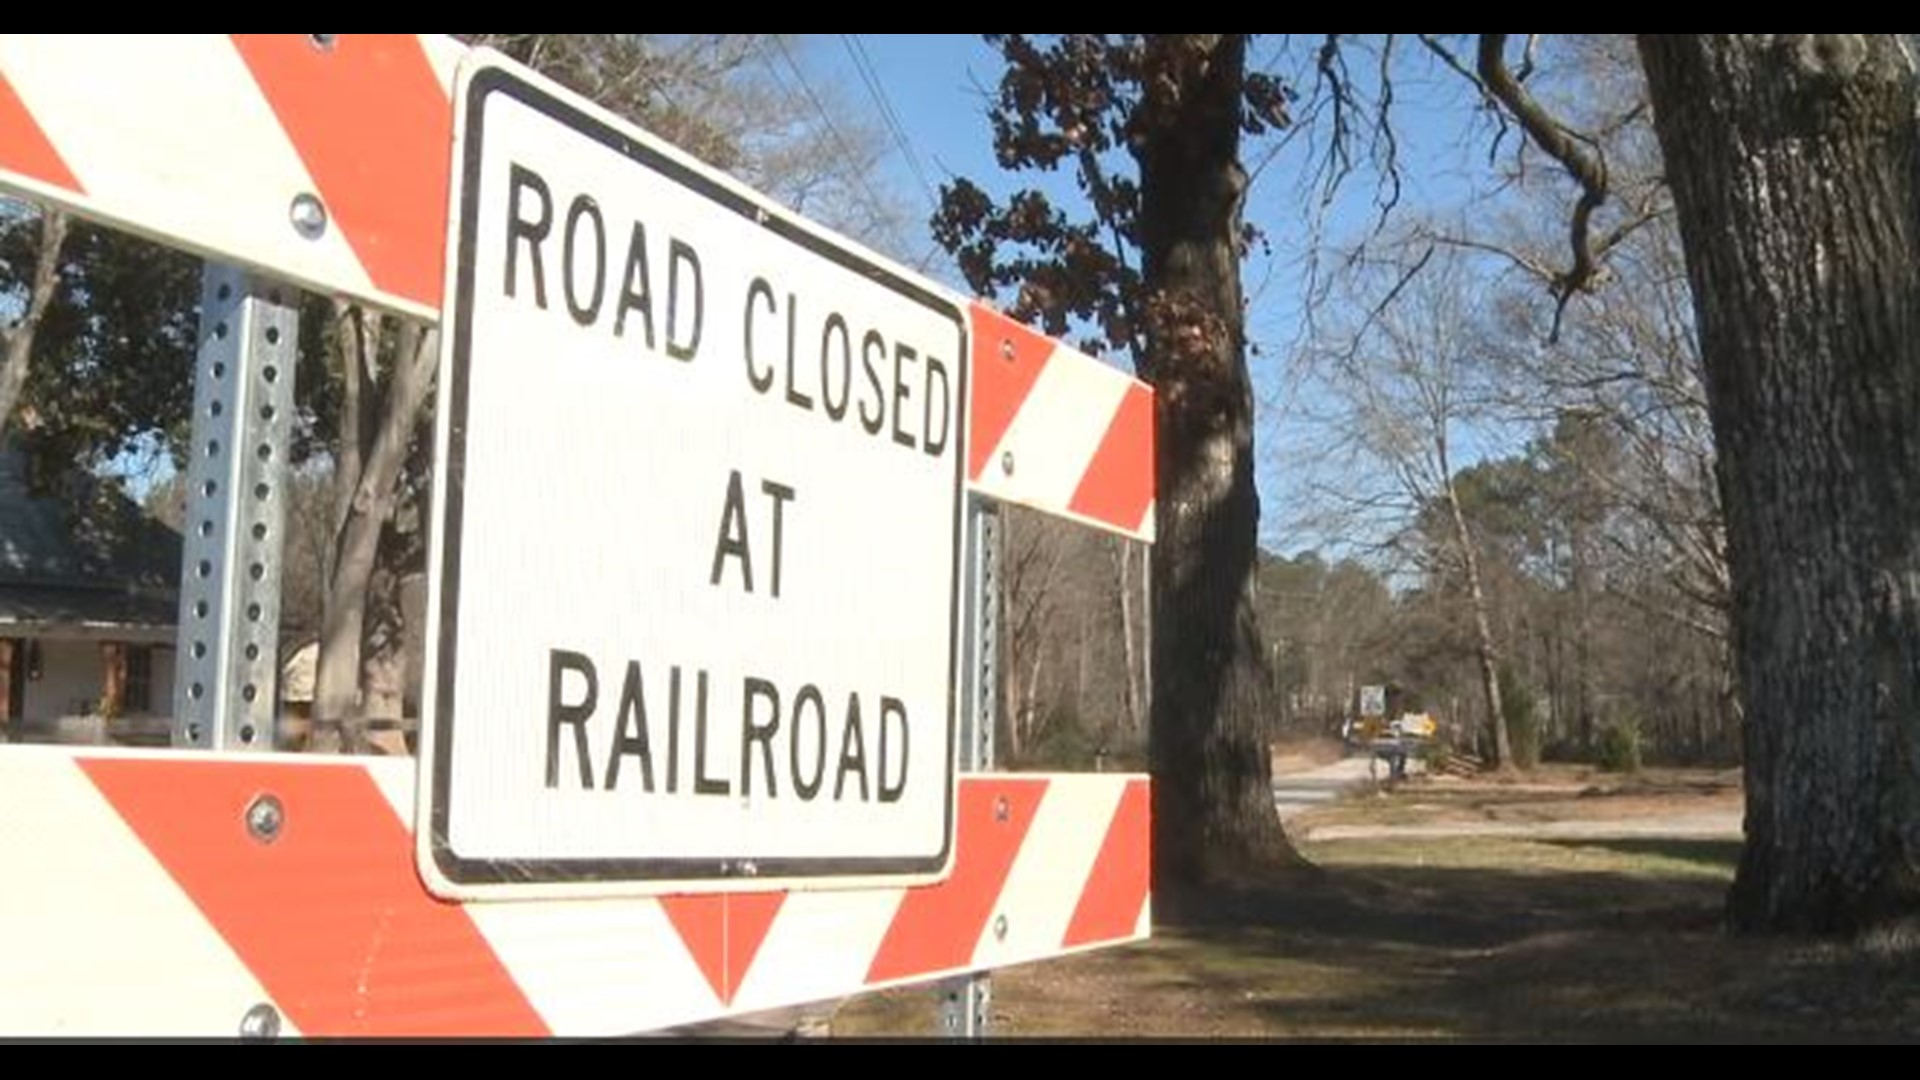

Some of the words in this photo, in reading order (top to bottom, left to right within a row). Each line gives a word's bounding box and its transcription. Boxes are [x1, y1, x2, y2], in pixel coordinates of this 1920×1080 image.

[505, 162, 705, 363] ROAD
[744, 276, 950, 458] CLOSED
[711, 470, 795, 599] AT
[545, 649, 910, 804] RAILROAD
